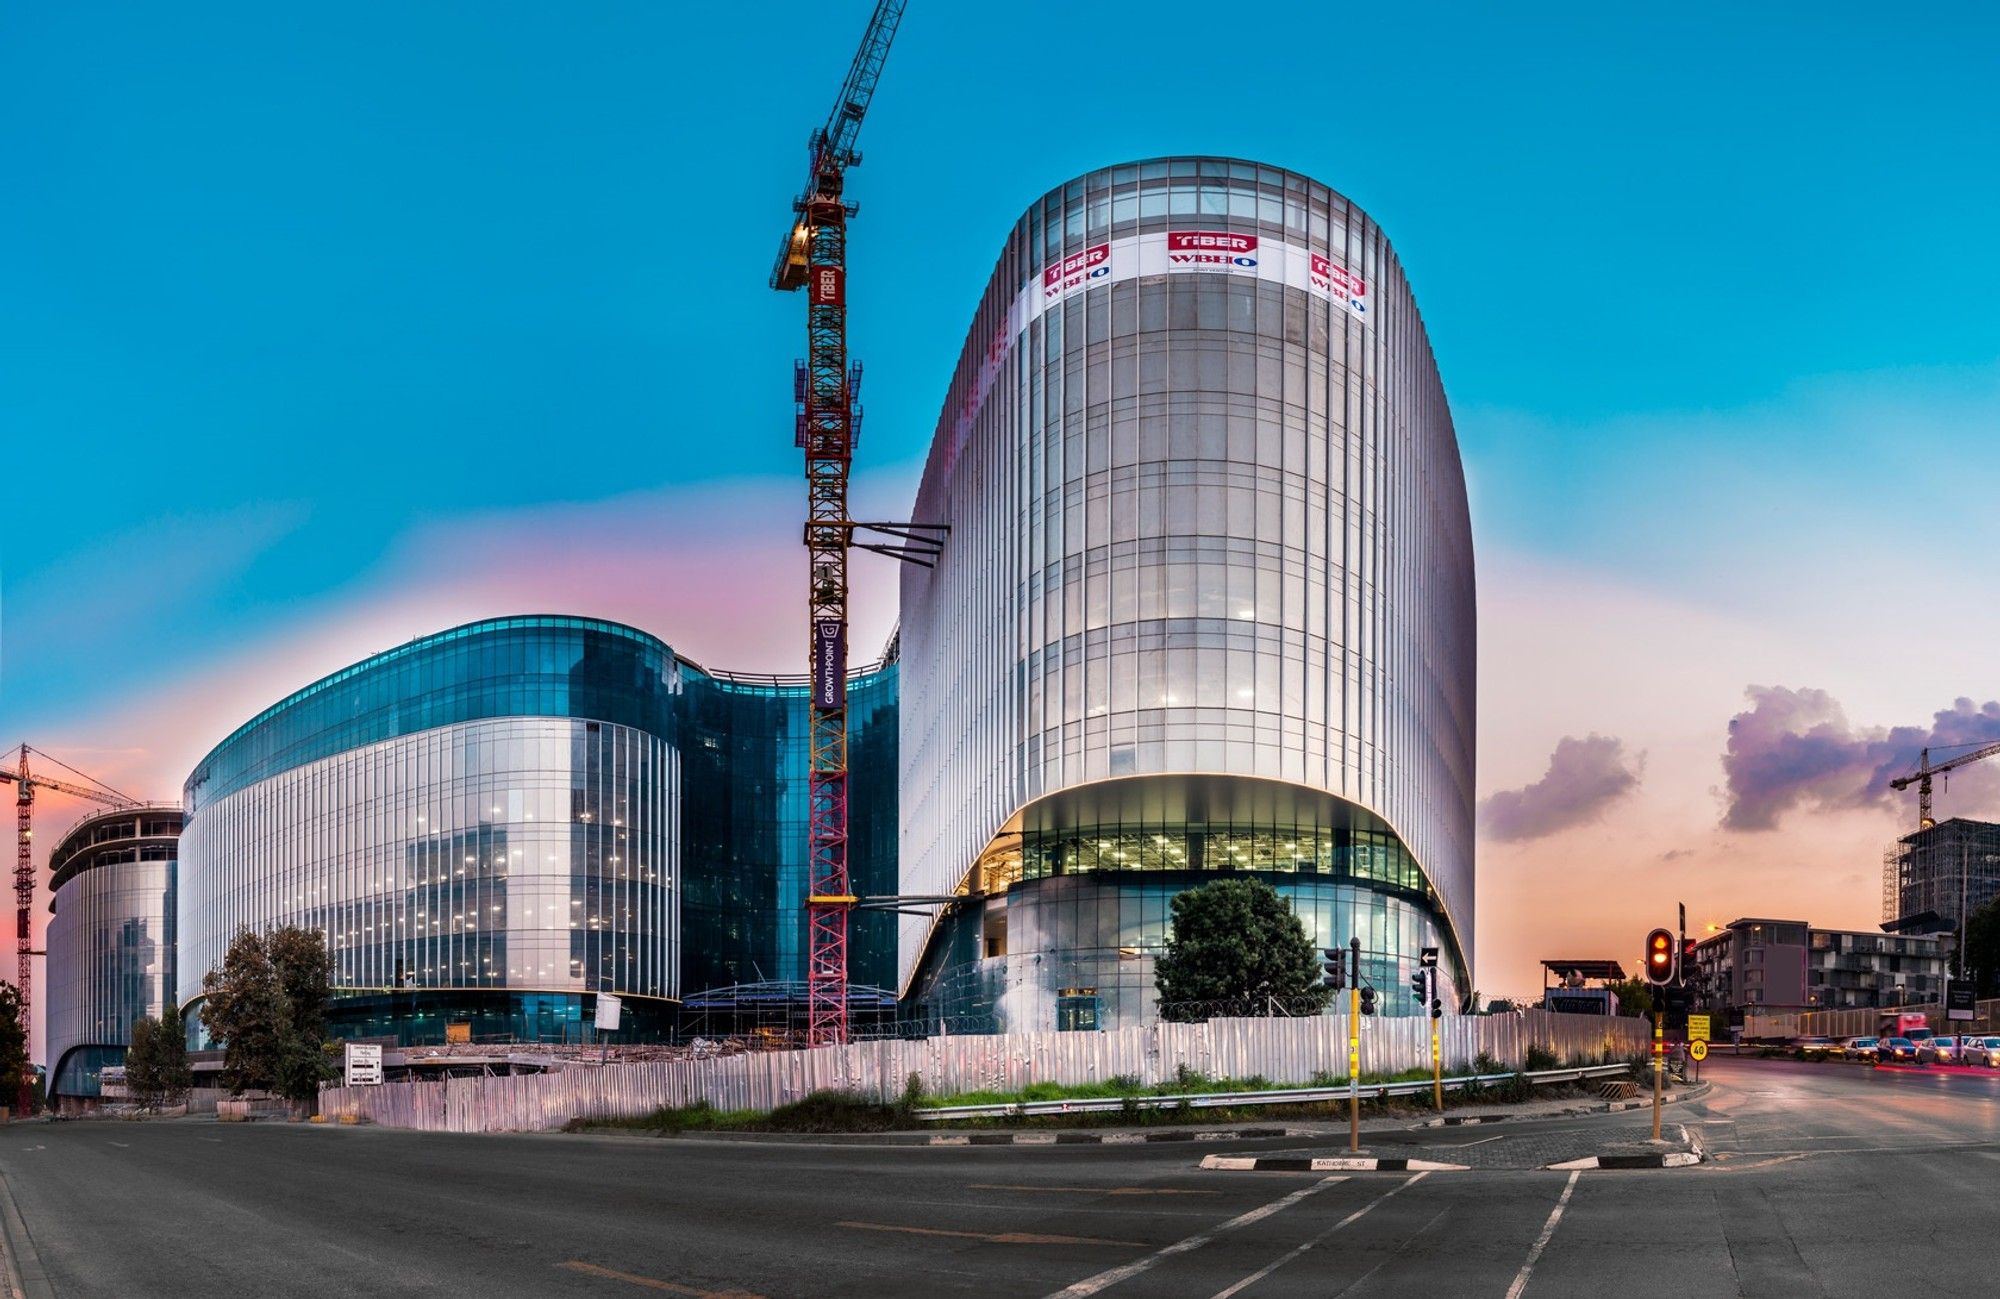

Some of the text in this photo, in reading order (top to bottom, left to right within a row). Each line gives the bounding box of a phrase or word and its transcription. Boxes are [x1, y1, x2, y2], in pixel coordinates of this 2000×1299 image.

[1049, 250, 1104, 279] TBER
[1169, 255, 1259, 267] WBHO
[825, 641, 834, 704] GROWTHPOINT
[1694, 1045, 1705, 1055] 40
